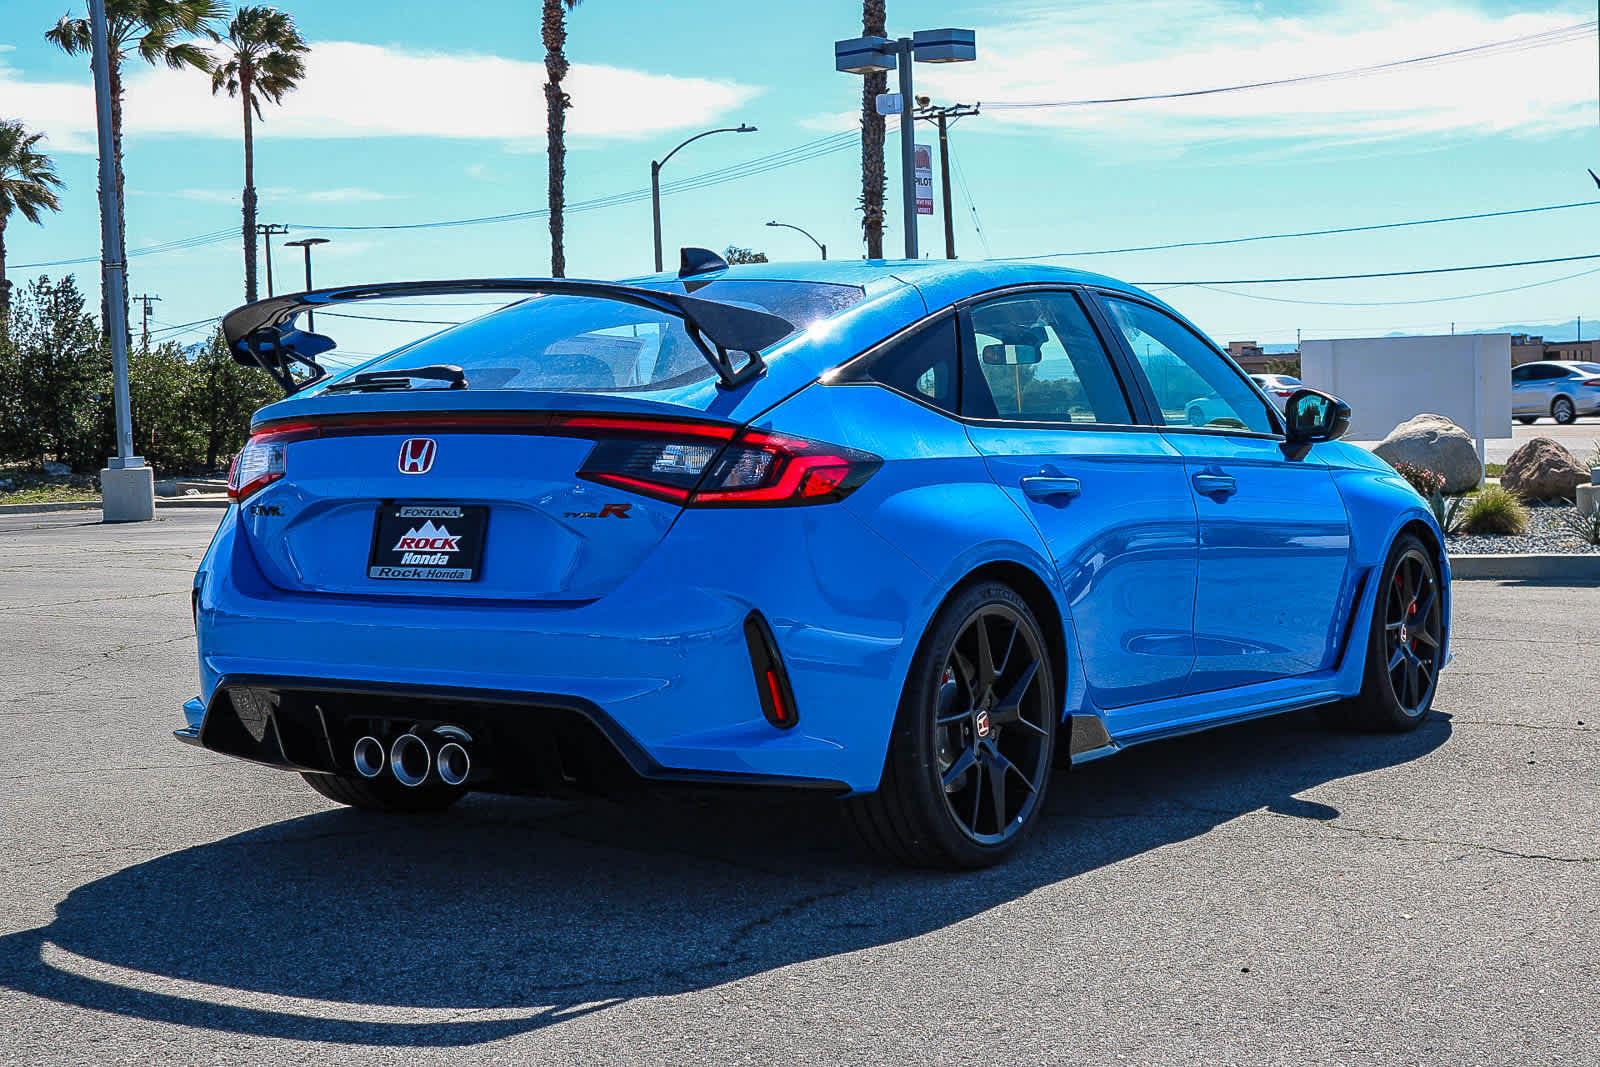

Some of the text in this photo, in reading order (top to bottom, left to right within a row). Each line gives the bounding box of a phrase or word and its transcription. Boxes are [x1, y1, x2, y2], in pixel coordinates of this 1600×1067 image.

[914, 177, 932, 186] PILOT
[403, 508, 458, 517] FONTANA
[599, 504, 632, 519] R
[398, 537, 457, 549] ROCK
[401, 552, 449, 565] Honda
[378, 567, 465, 579] Rock Honda
